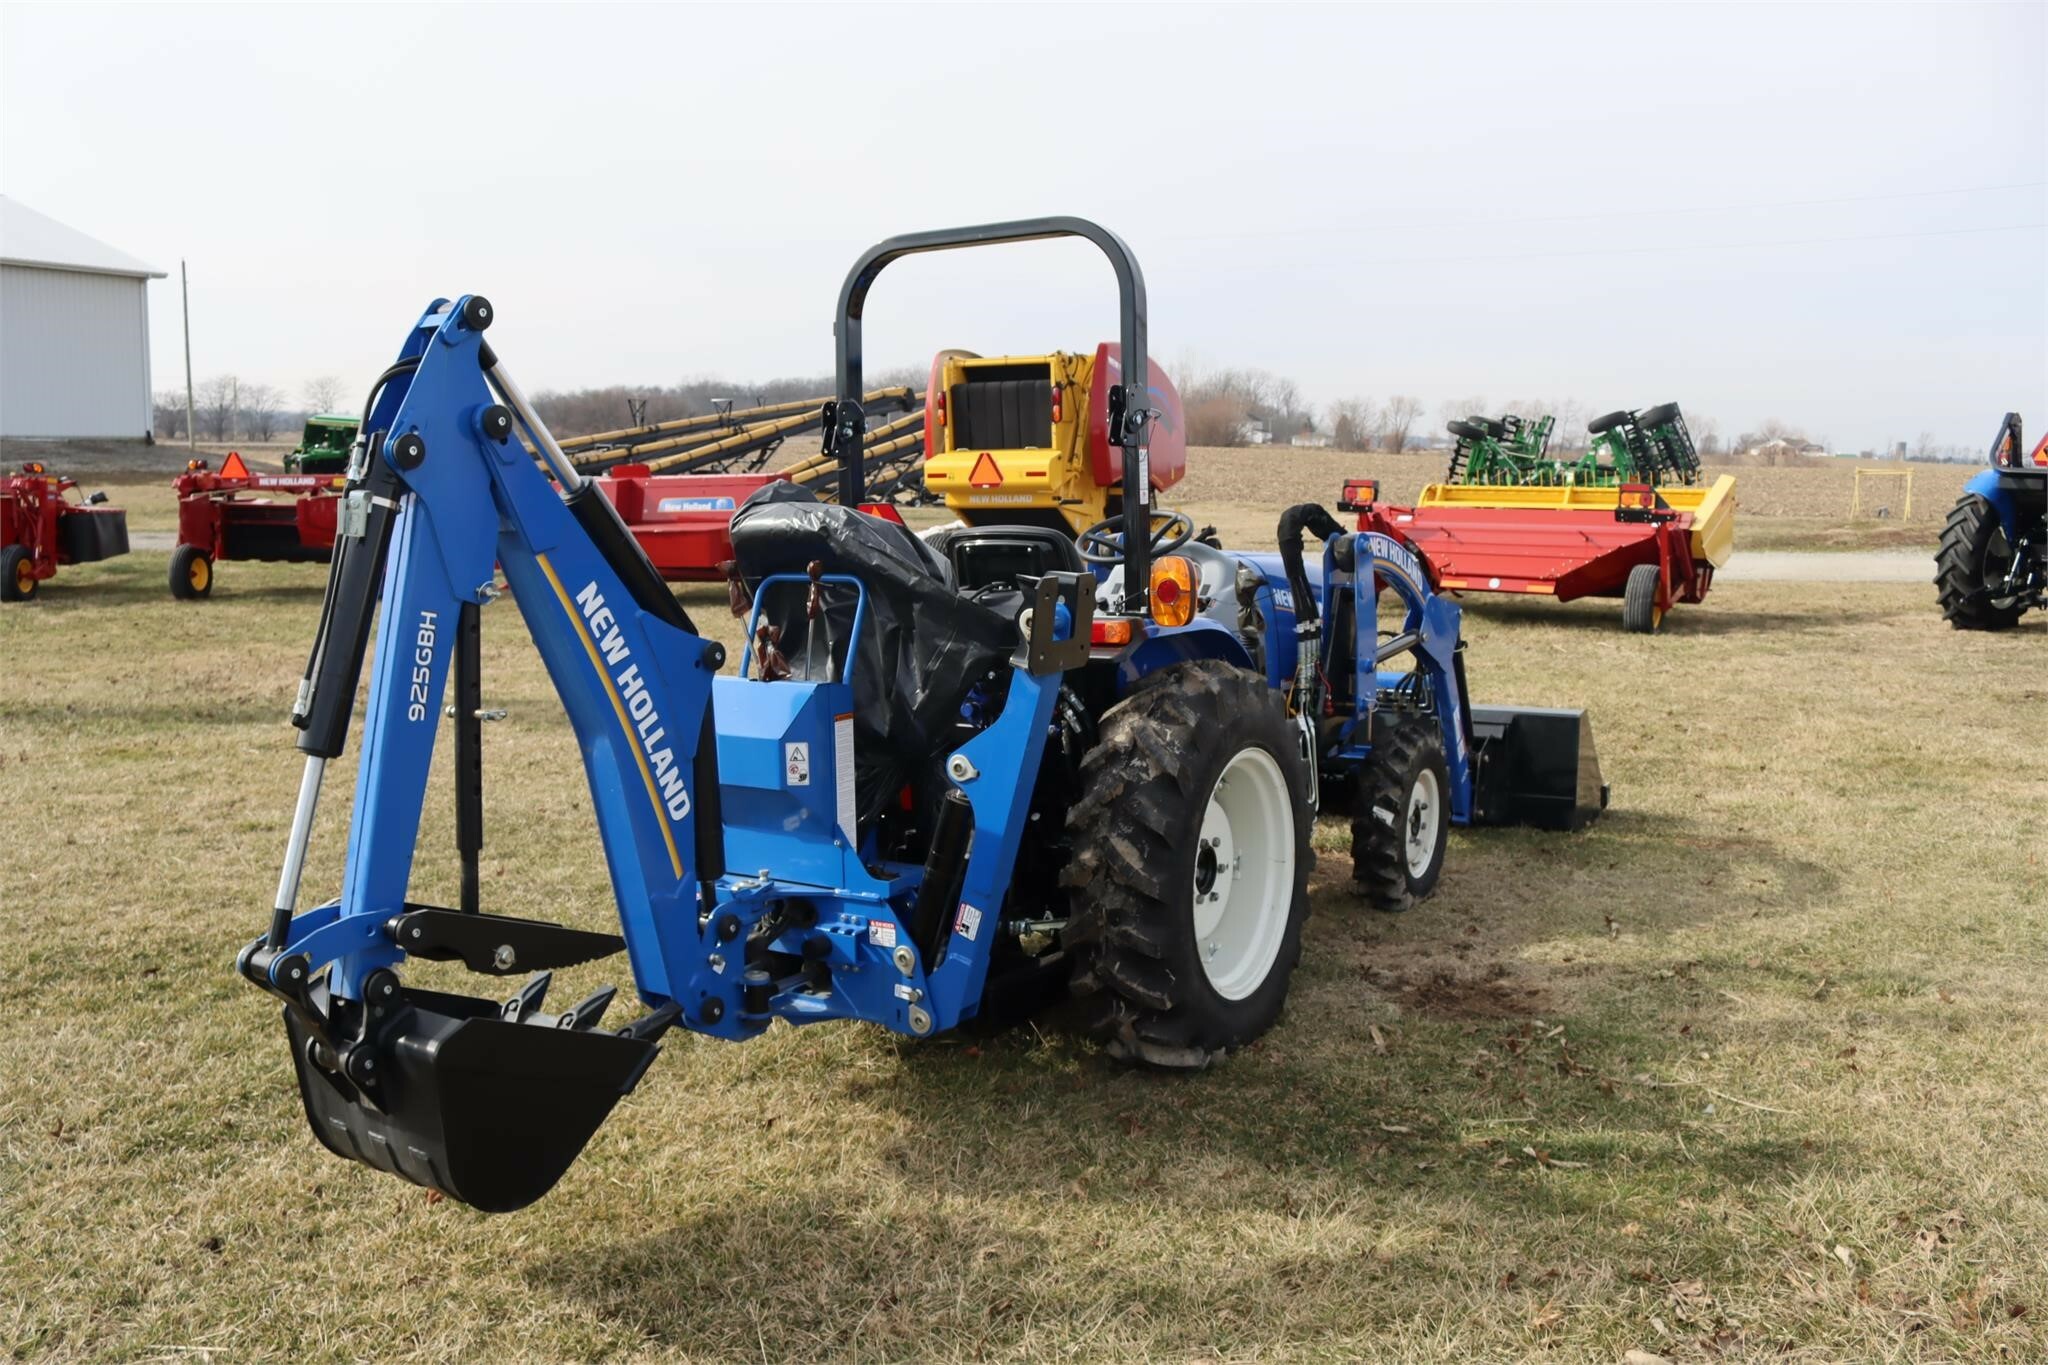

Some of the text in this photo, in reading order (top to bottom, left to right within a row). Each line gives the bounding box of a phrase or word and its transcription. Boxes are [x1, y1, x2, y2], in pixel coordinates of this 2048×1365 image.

[259, 477, 315, 486] NEW HOLLAND
[969, 495, 1033, 504] NEW HOLLAND
[1369, 536, 1423, 592] NEW HOLLAND
[408, 611, 437, 721] 925GBH
[575, 580, 691, 822] NEW HOLLAND
